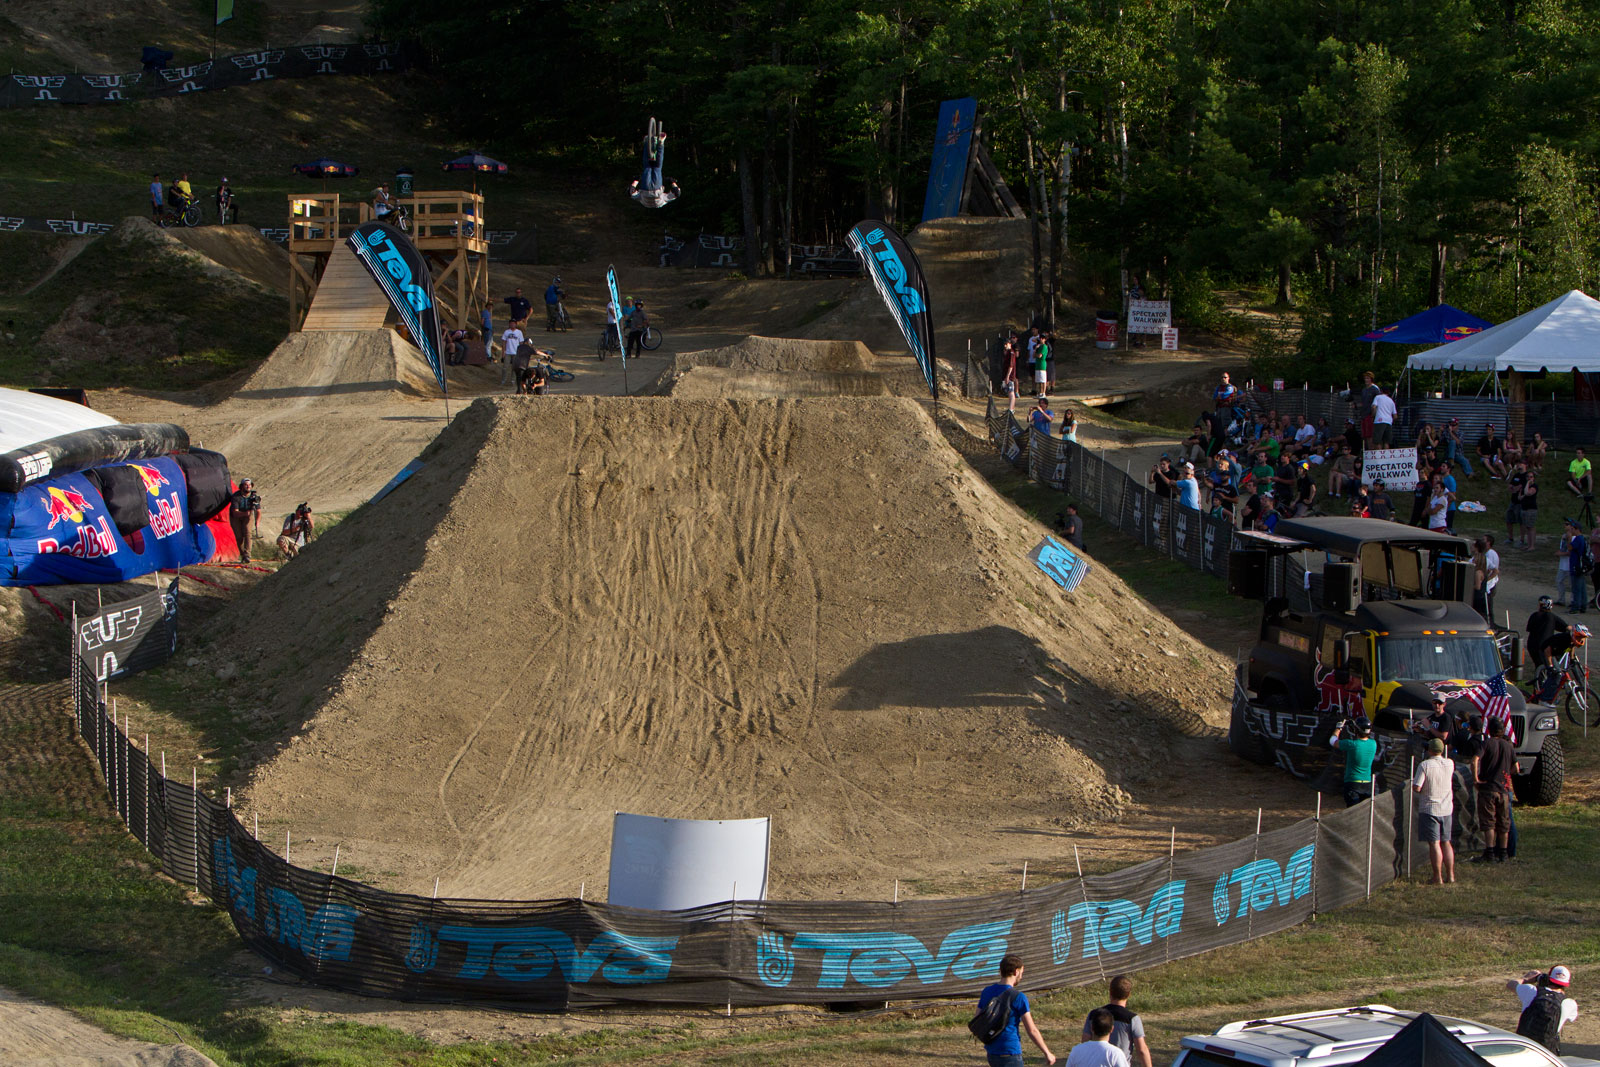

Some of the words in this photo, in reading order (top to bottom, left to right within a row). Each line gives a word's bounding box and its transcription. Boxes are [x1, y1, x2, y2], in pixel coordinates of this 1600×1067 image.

[1132, 310, 1167, 318] SPECTATOR
[1365, 462, 1414, 472] SPECTATOR
[1367, 470, 1412, 480] WALKWAY
[84, 515, 119, 559] Bull
[160, 491, 184, 537] Bull
[1229, 844, 1316, 918] Teva
[1067, 880, 1187, 959] Teva
[438, 924, 680, 984] Teva
[792, 918, 1016, 990] Teva
